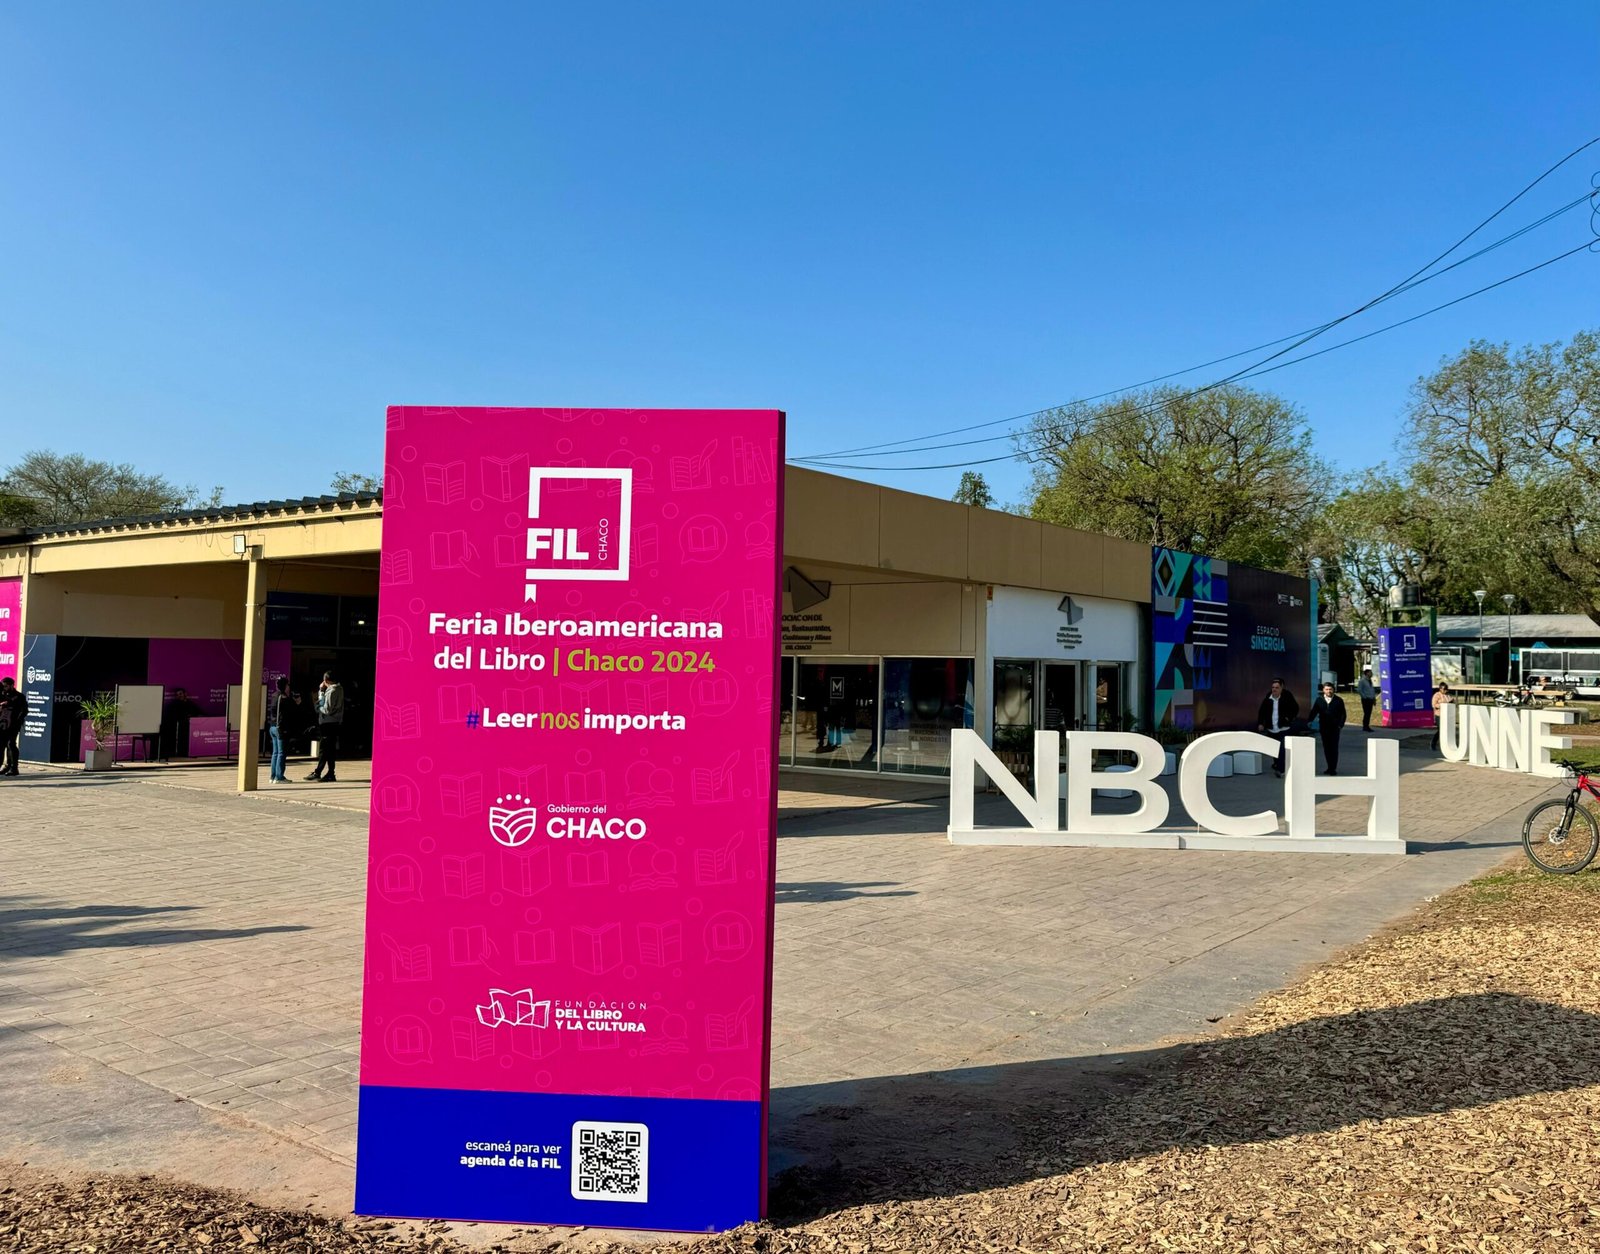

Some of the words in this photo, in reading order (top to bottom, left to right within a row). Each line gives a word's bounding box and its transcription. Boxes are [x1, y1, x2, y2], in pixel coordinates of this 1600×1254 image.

[526, 528, 589, 560] FIL
[598, 518, 609, 561] CHACO
[429, 612, 498, 635] Feria
[504, 612, 723, 638] Iberoamericana
[1257, 625, 1280, 637] ESPACIO
[1250, 635, 1286, 652] SINERGIA
[433, 646, 472, 670] del
[479, 647, 546, 671] Libro
[567, 648, 644, 673] Chaco
[651, 650, 716, 673] 2024
[36, 673, 52, 682] CHACO
[1439, 703, 1574, 777] UNNE
[950, 728, 1400, 840] NBCH
[547, 804, 590, 814] Gobierno
[592, 804, 607, 814] del
[546, 817, 647, 840] CHACO
[555, 1000, 647, 1010] FUNDACIÓN
[555, 1009, 580, 1019] DEL
[583, 1009, 623, 1020] LIBRO
[555, 1020, 563, 1030] Y
[567, 1020, 583, 1031] LA
[587, 1021, 647, 1032] CULTURA
[465, 1140, 512, 1152] escaneá
[514, 1143, 540, 1155] para
[542, 1144, 562, 1155] ver
[460, 1155, 506, 1168] agenda
[508, 1156, 524, 1168] de
[527, 1156, 538, 1168] la
[541, 1158, 562, 1169] FIL
